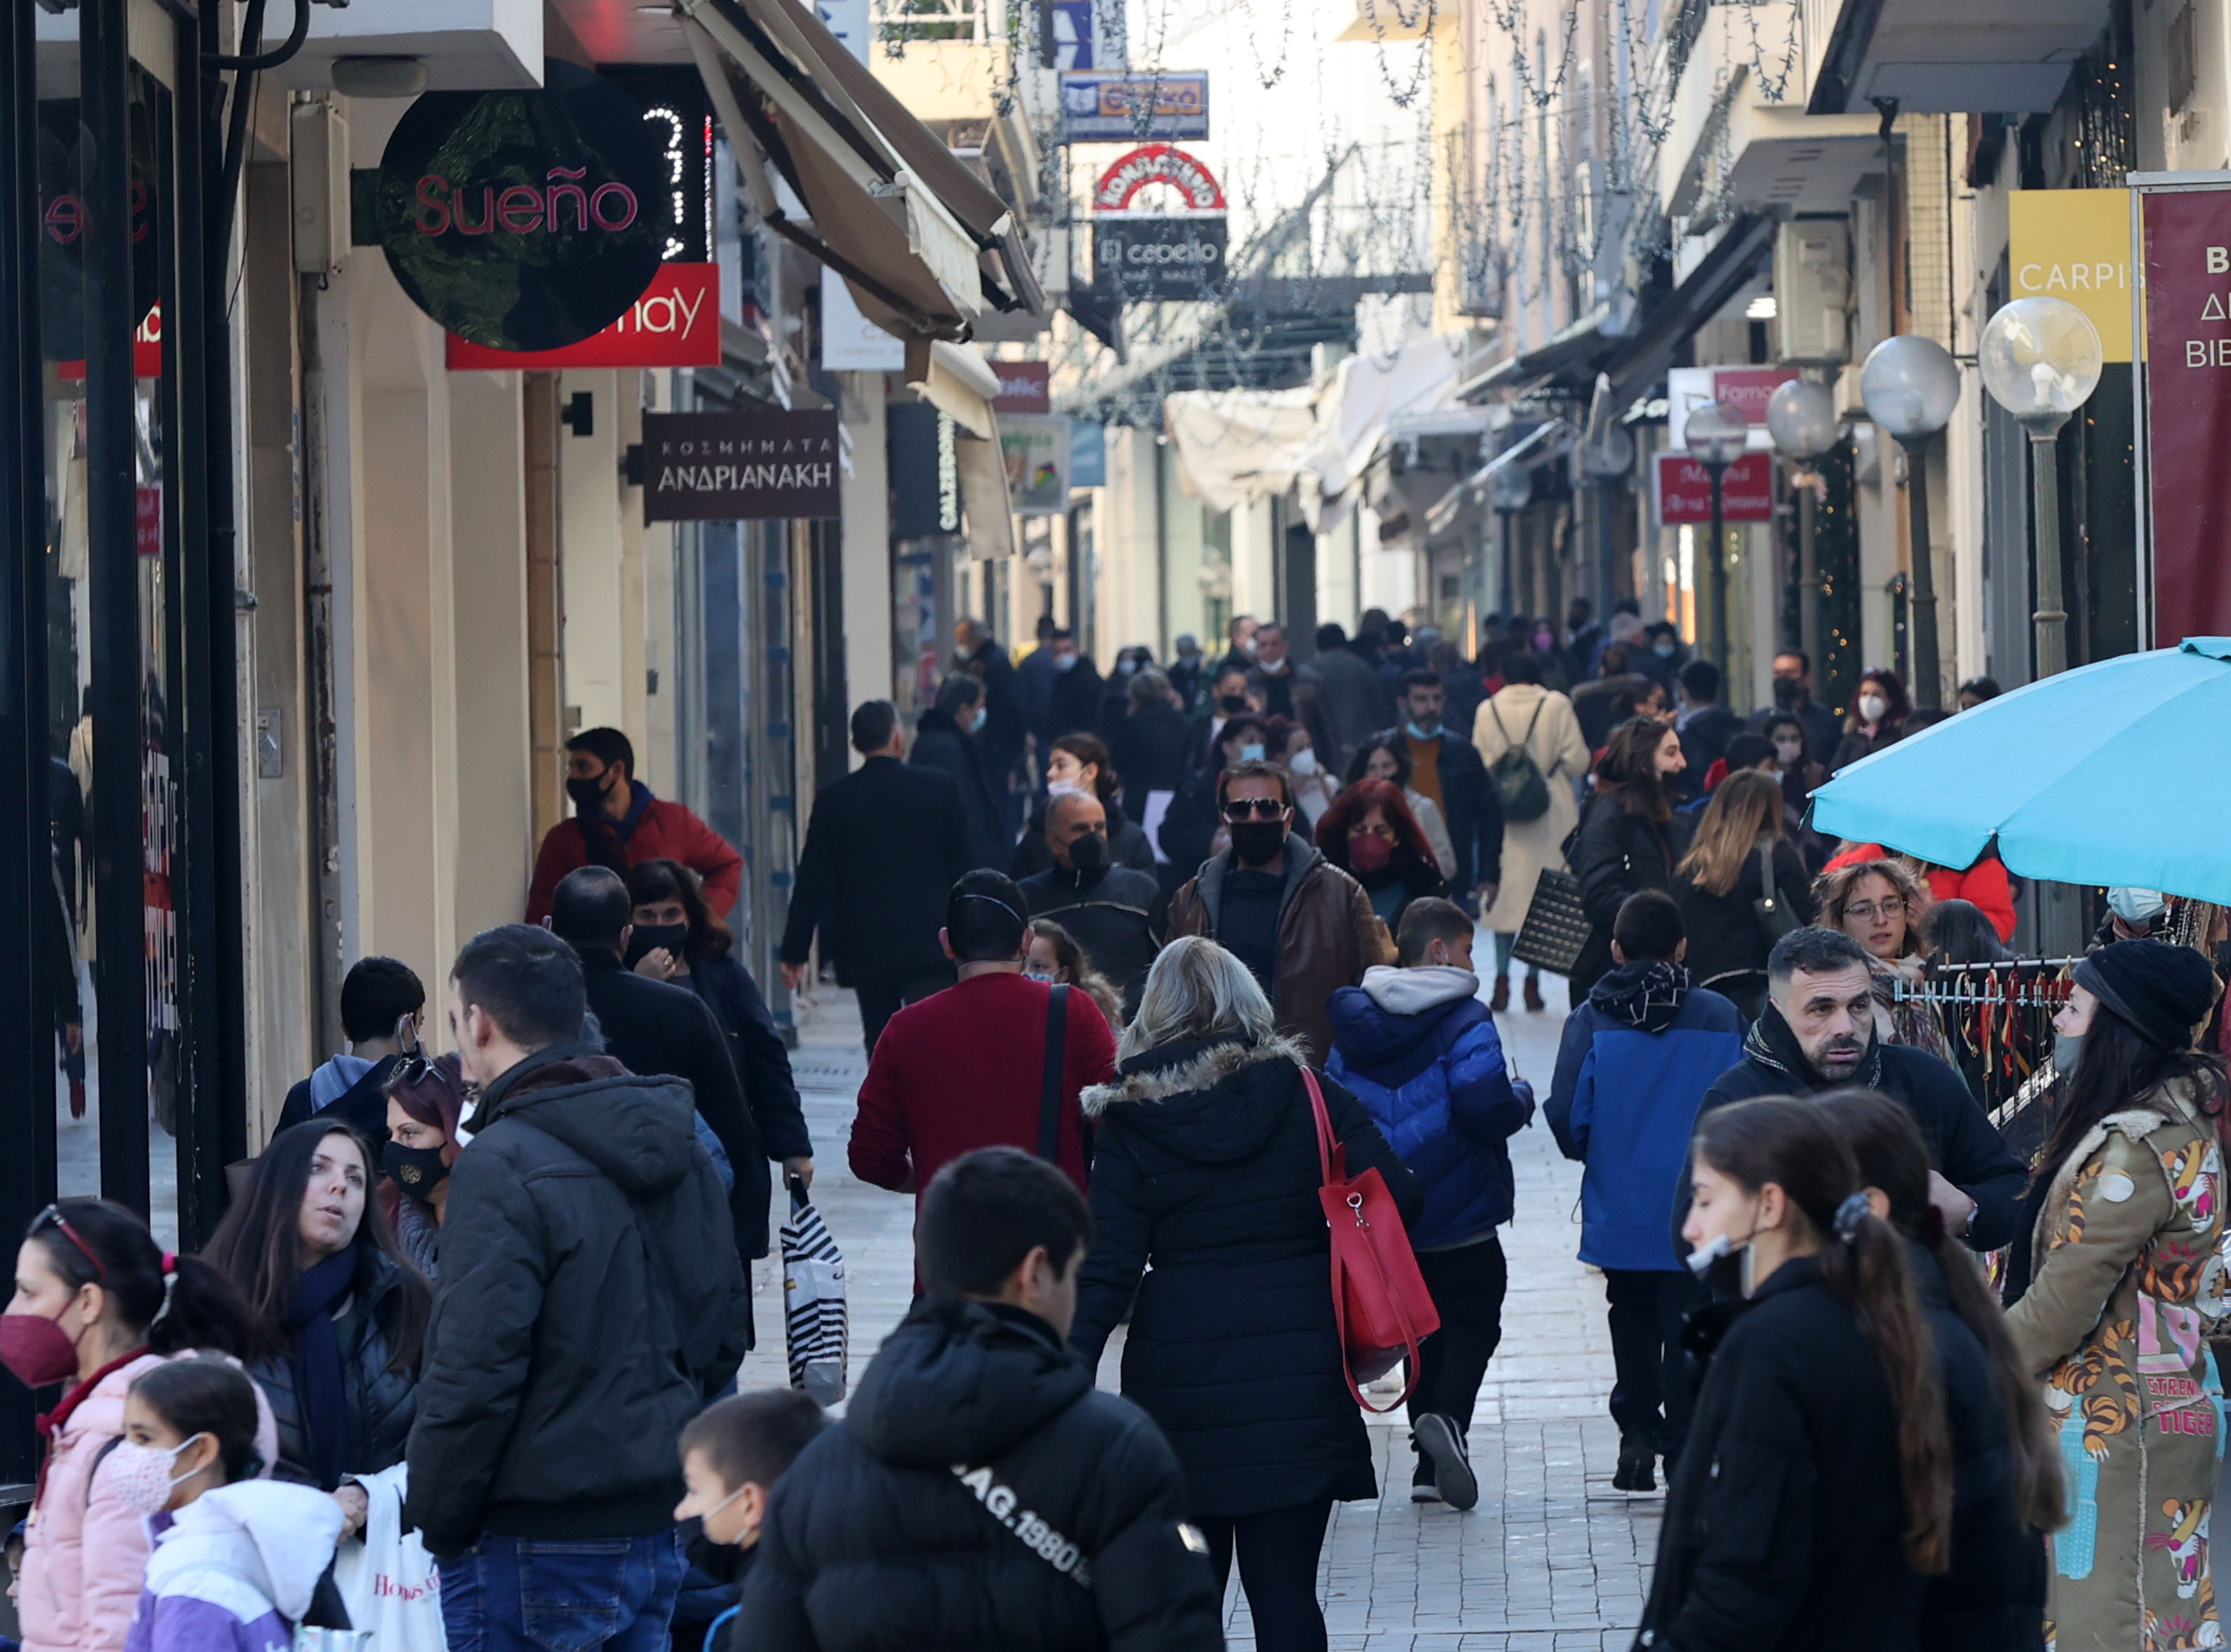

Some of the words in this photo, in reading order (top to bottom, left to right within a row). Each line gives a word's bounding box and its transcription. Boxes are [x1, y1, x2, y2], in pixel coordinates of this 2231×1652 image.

[416, 166, 637, 236] Sueño
[661, 438, 833, 456] ΚΟΣΜΗΜΑΤΑ
[658, 462, 833, 492] ΑΝΔΡΙΑΝΑΚΗ
[2156, 1408, 2214, 1438] TIGER
